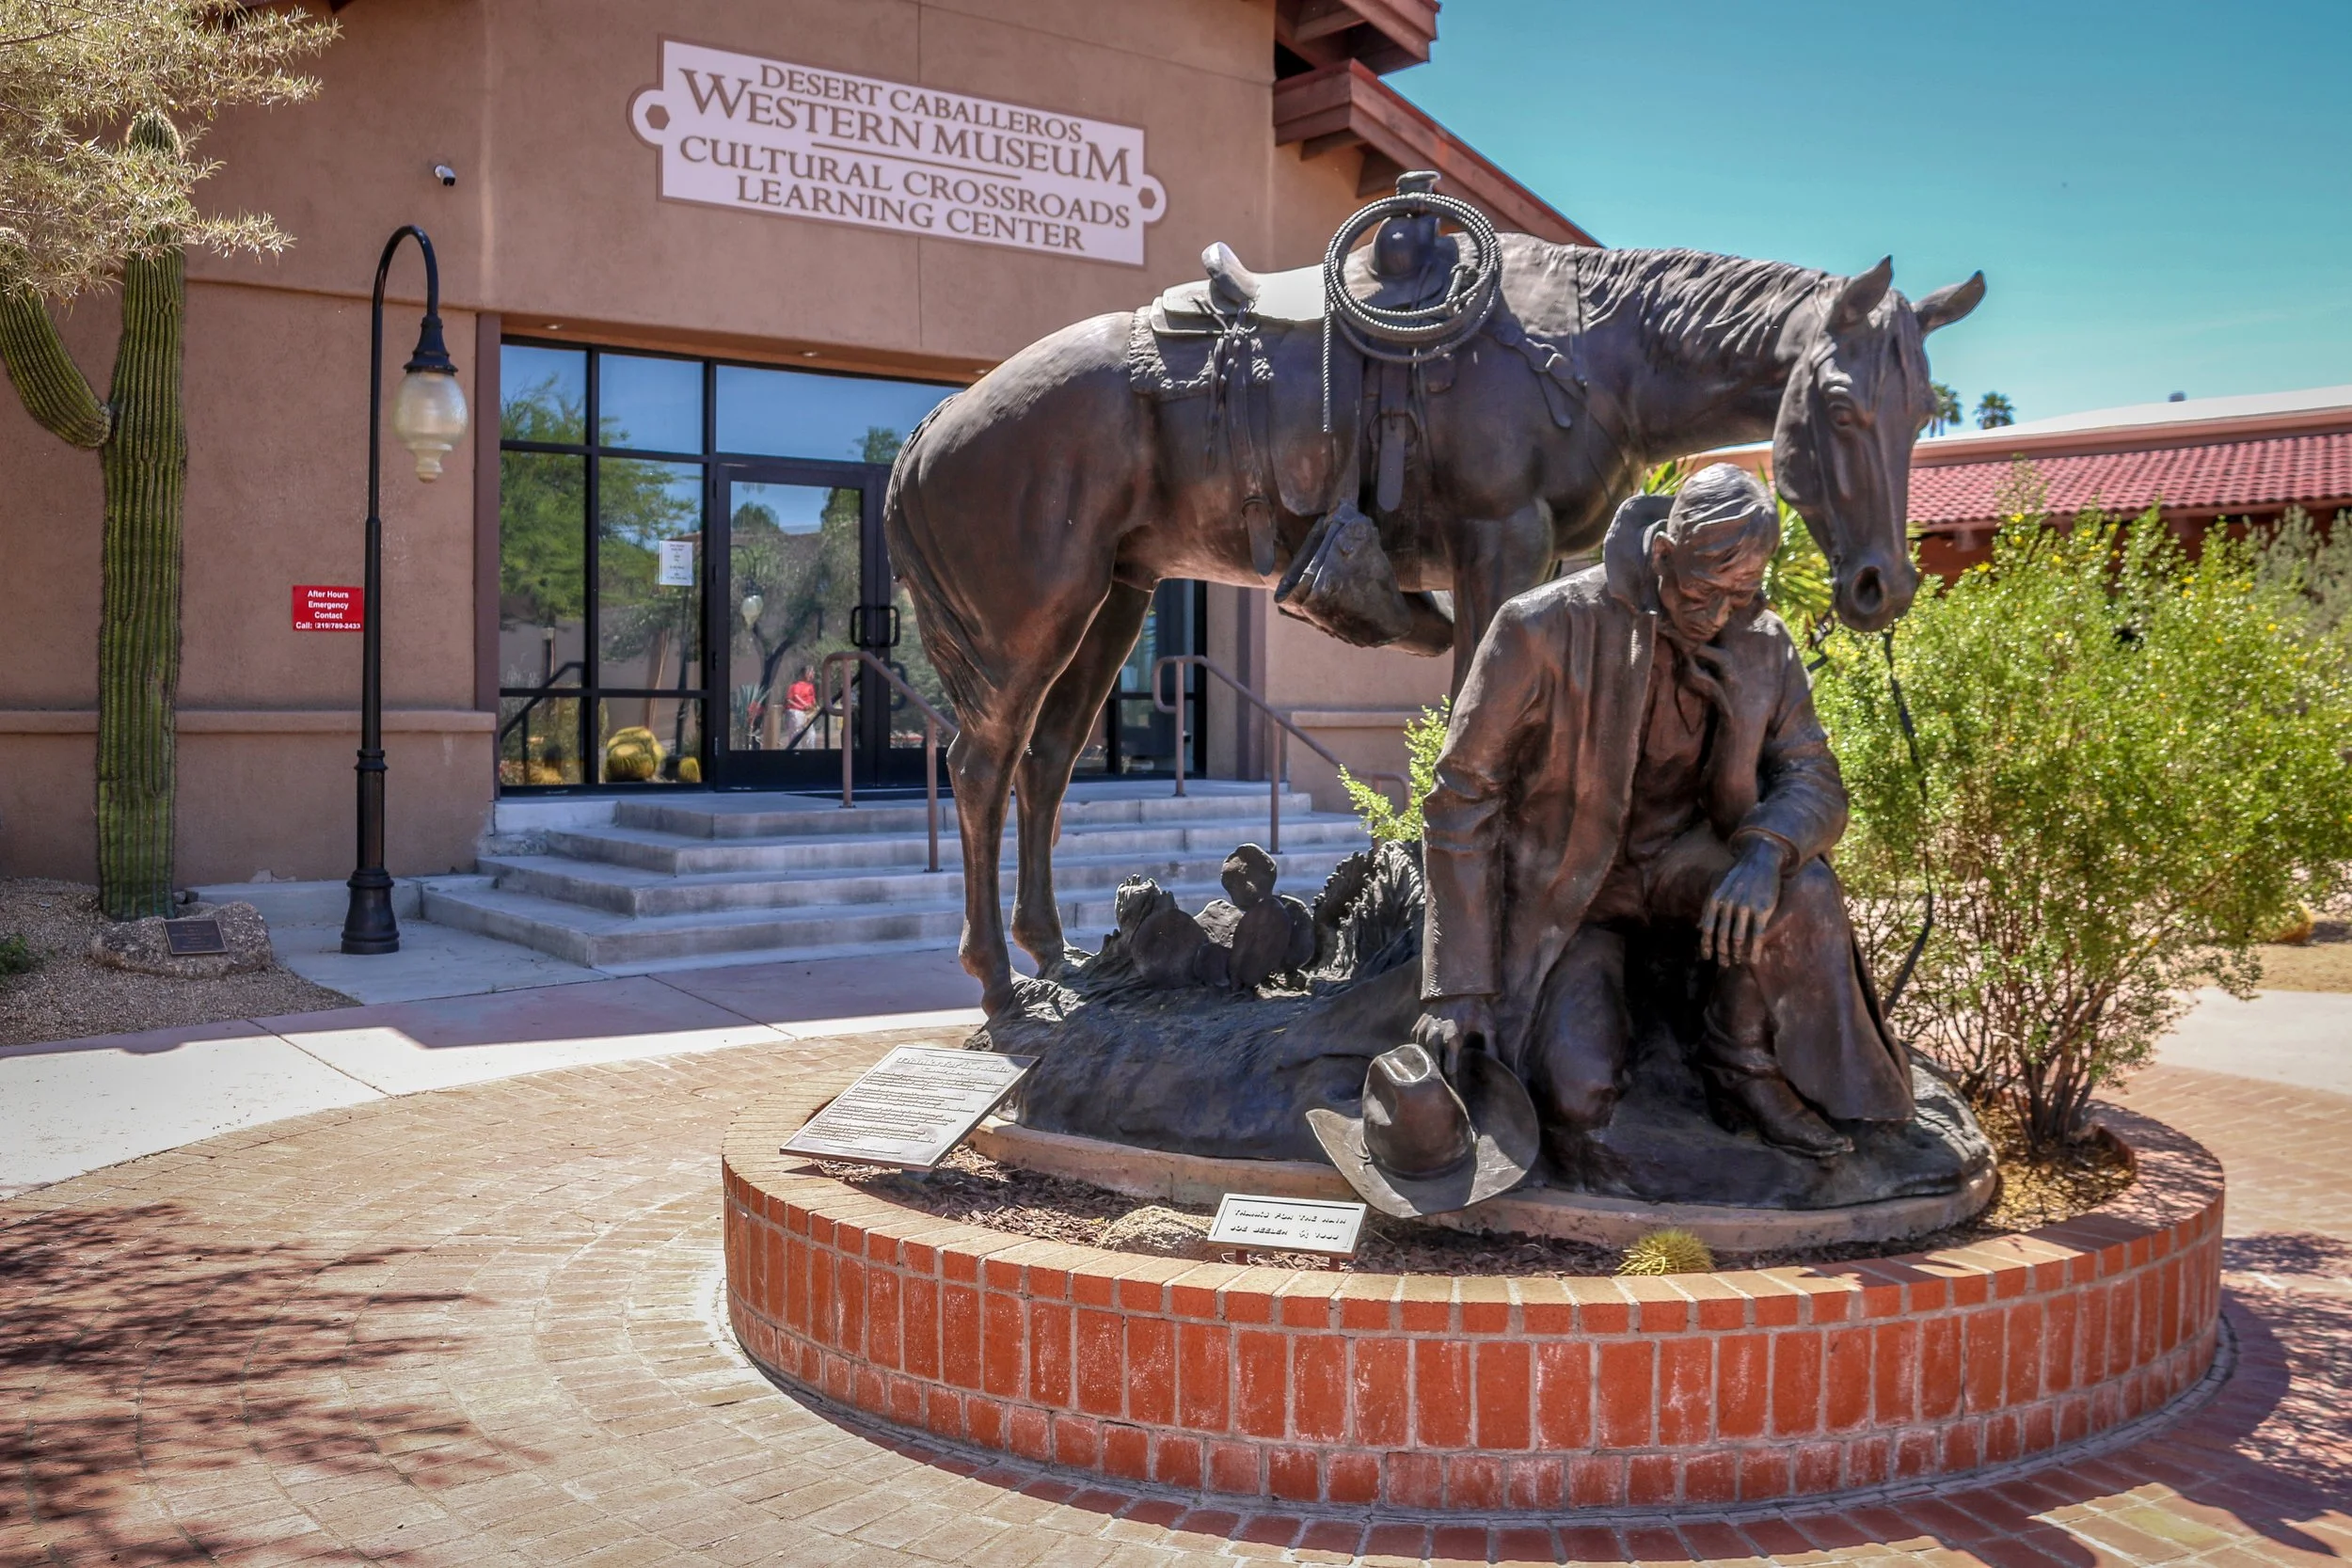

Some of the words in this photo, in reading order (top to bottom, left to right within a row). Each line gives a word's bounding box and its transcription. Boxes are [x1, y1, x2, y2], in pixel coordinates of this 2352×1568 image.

[677, 67, 923, 150] WESTERN
[931, 123, 1132, 187] MUSEUM
[760, 63, 882, 107] DESERT
[889, 89, 1083, 144] CABALLEROS
[679, 135, 893, 192] CULTURAL
[902, 170, 1131, 230] CROSSROADS
[737, 175, 934, 229] LEARNING
[946, 208, 1085, 251] CENTER
[308, 590, 326, 598] After
[308, 600, 349, 610] Emergency
[314, 611, 343, 620] Contact
